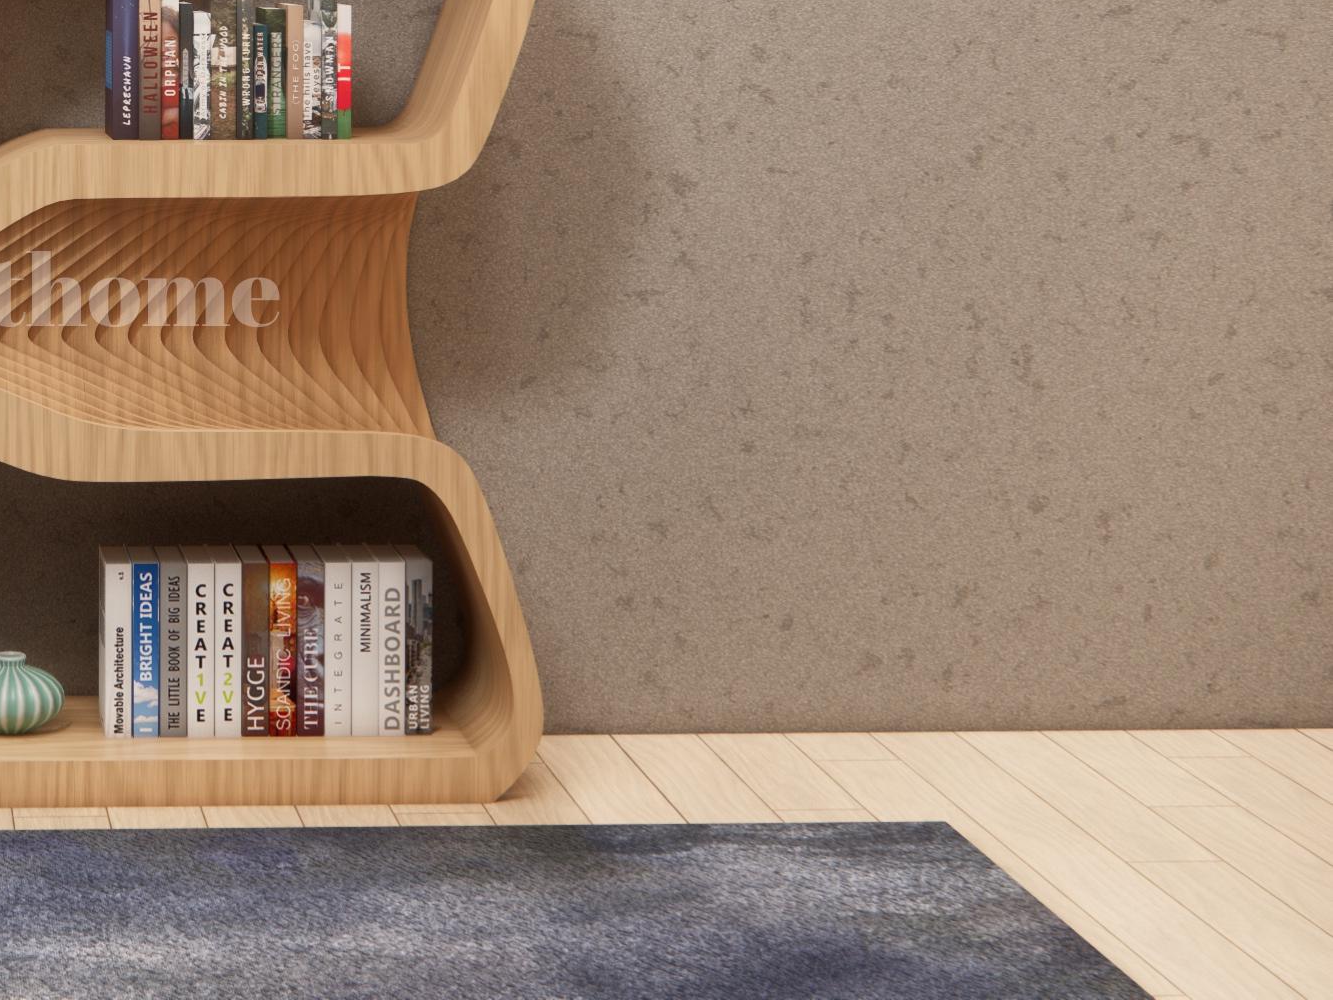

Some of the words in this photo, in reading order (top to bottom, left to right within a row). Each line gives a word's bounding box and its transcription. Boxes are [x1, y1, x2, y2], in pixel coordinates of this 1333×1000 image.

[143, 12, 158, 114] HALLOWEEN
[164, 40, 176, 97] ORPHAN
[242, 33, 251, 61] TURN
[325, 36, 334, 101] SNOWMAN
[123, 56, 131, 126] LEPRECHAUN
[219, 76, 227, 87] IN
[242, 68, 251, 106] WRONG
[271, 32, 281, 115] STRANGERS
[303, 72, 311, 96] hills
[313, 69, 321, 92] eyes
[338, 63, 350, 81] IT
[219, 91, 227, 119] CABIN
[139, 572, 153, 618] IDEAS
[168, 576, 180, 602] IDEAS
[272, 578, 291, 637] LIVING
[168, 608, 180, 623] BIG
[168, 628, 180, 640] OF
[360, 572, 371, 652] MINIMALISM
[114, 627, 124, 689] Architecture
[139, 623, 153, 681] BRIGHT
[168, 646, 180, 671] BOOK
[222, 583, 234, 722] CREAT2VE
[304, 628, 318, 681] CUBE
[334, 583, 343, 725] INTEGRATE
[384, 588, 400, 730] DASHBOARD
[168, 678, 180, 706] LITTLE
[247, 657, 265, 730] HYGGE
[276, 648, 291, 730] SCANDIC
[304, 687, 318, 730] THE
[409, 685, 418, 729] URBAN
[420, 685, 430, 729] LIVING
[114, 692, 124, 734] Movable
[168, 712, 180, 730] THE
